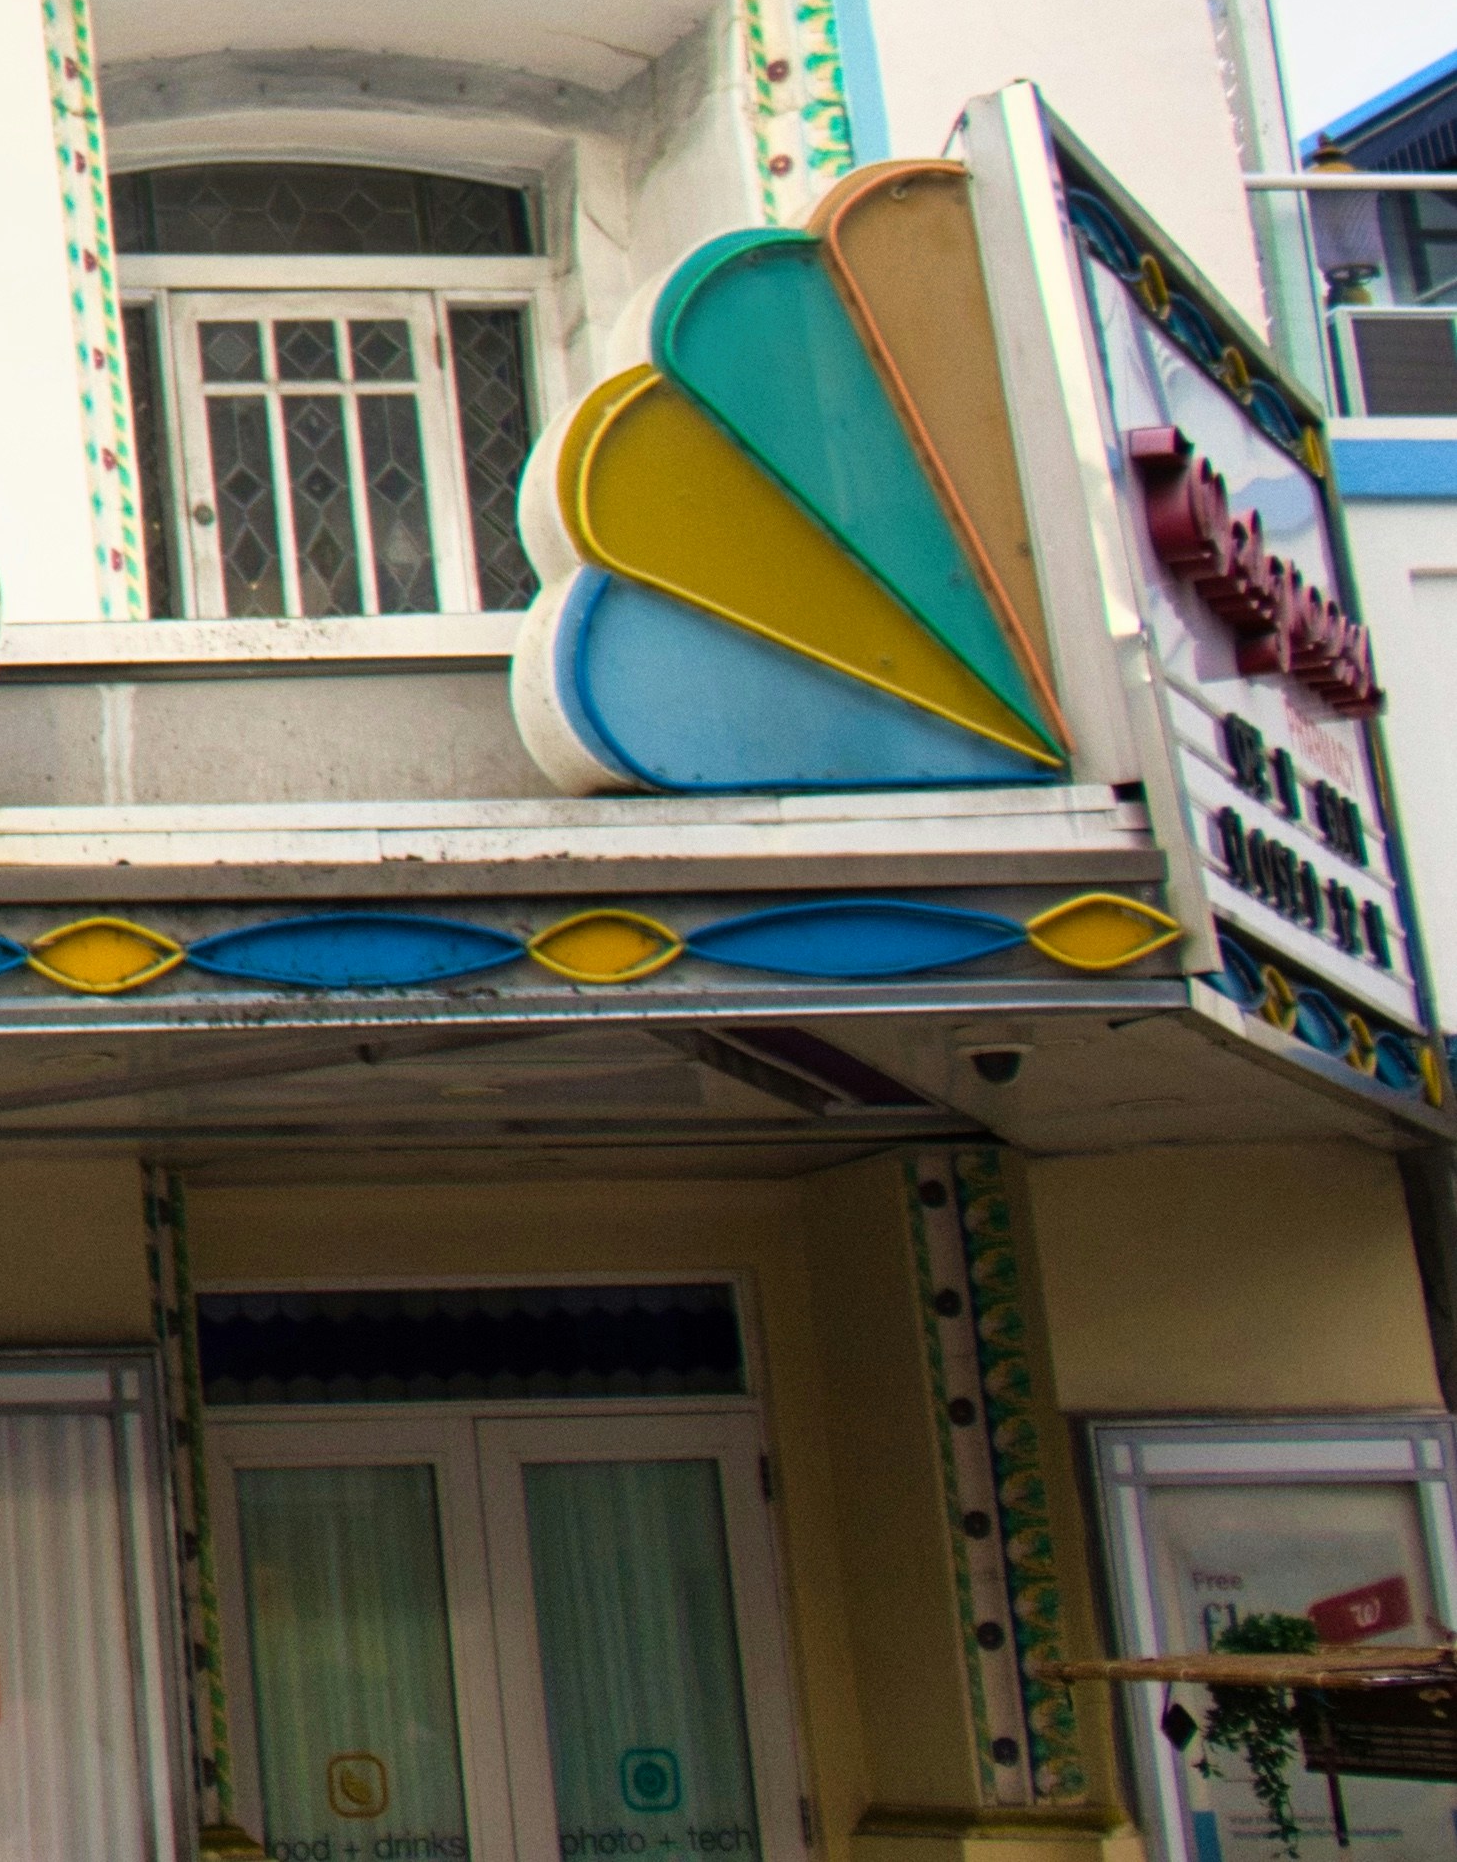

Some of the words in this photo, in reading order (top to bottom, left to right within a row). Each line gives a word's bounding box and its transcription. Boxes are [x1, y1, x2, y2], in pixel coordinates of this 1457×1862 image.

[1191, 1570, 1242, 1590] Free
[269, 1834, 329, 1862] ood
[375, 1833, 467, 1862] drinks
[563, 1826, 644, 1861] photo
[688, 1825, 752, 1854] tech
